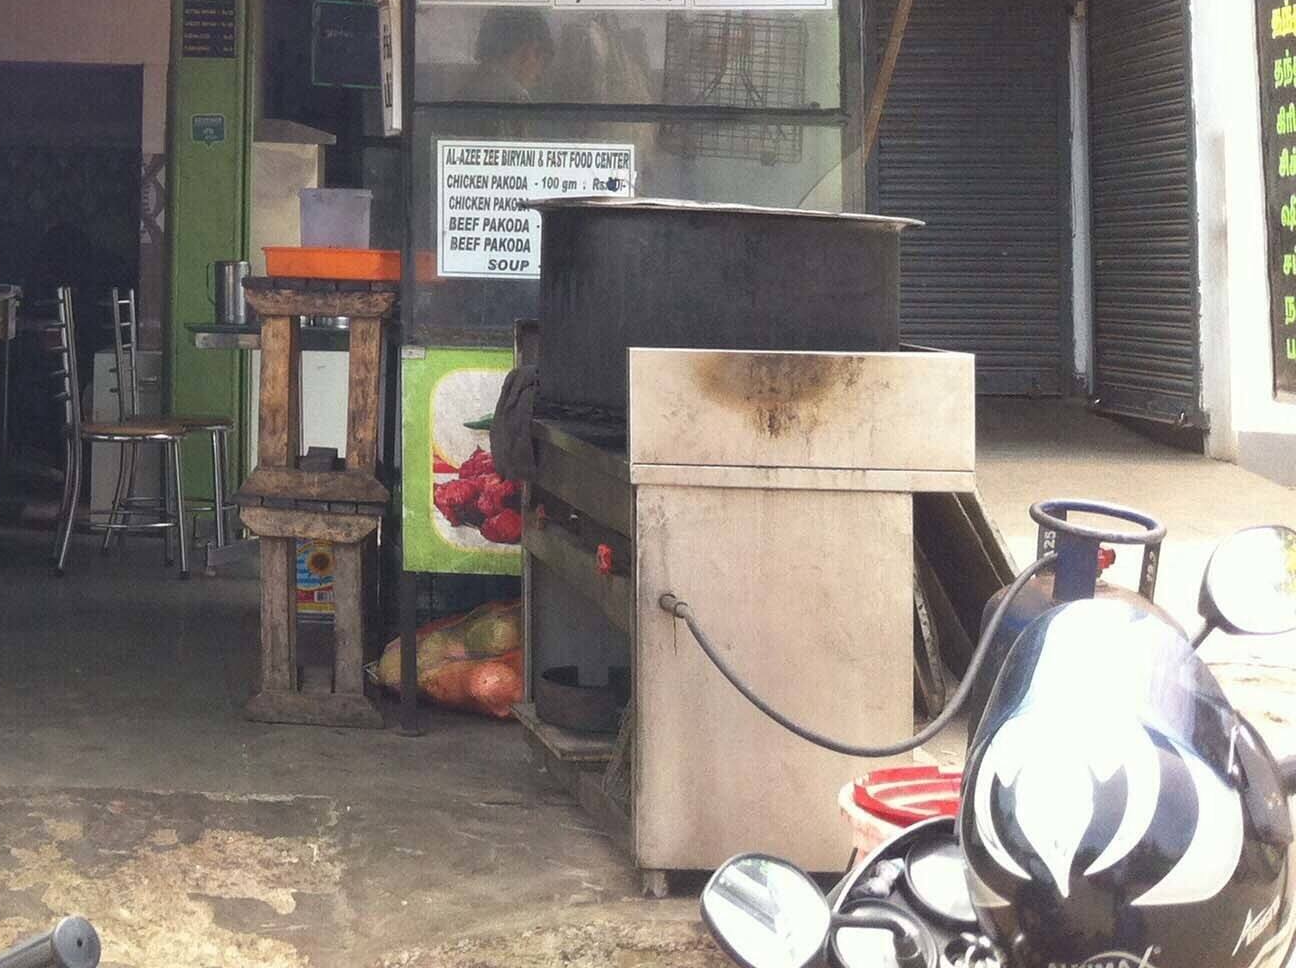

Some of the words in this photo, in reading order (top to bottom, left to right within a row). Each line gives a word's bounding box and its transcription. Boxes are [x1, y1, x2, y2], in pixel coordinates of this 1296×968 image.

[446, 148, 482, 167] AL-AZEE
[483, 149, 499, 167] ZEE
[502, 150, 535, 168] BIRYANI
[546, 151, 568, 168] FAST
[570, 151, 593, 169] FOOD
[595, 152, 630, 170] CENTER
[447, 174, 488, 189] CHICKEN
[490, 175, 528, 190] PAKODA
[541, 177, 560, 190] 100
[562, 179, 577, 193] gm
[449, 195, 490, 210] CHICKEN
[449, 217, 479, 232] BEEF
[482, 218, 529, 233] PAKODA
[450, 236, 480, 251] BEEF
[483, 237, 531, 253] PAKODA
[488, 259, 530, 272] SOUP
